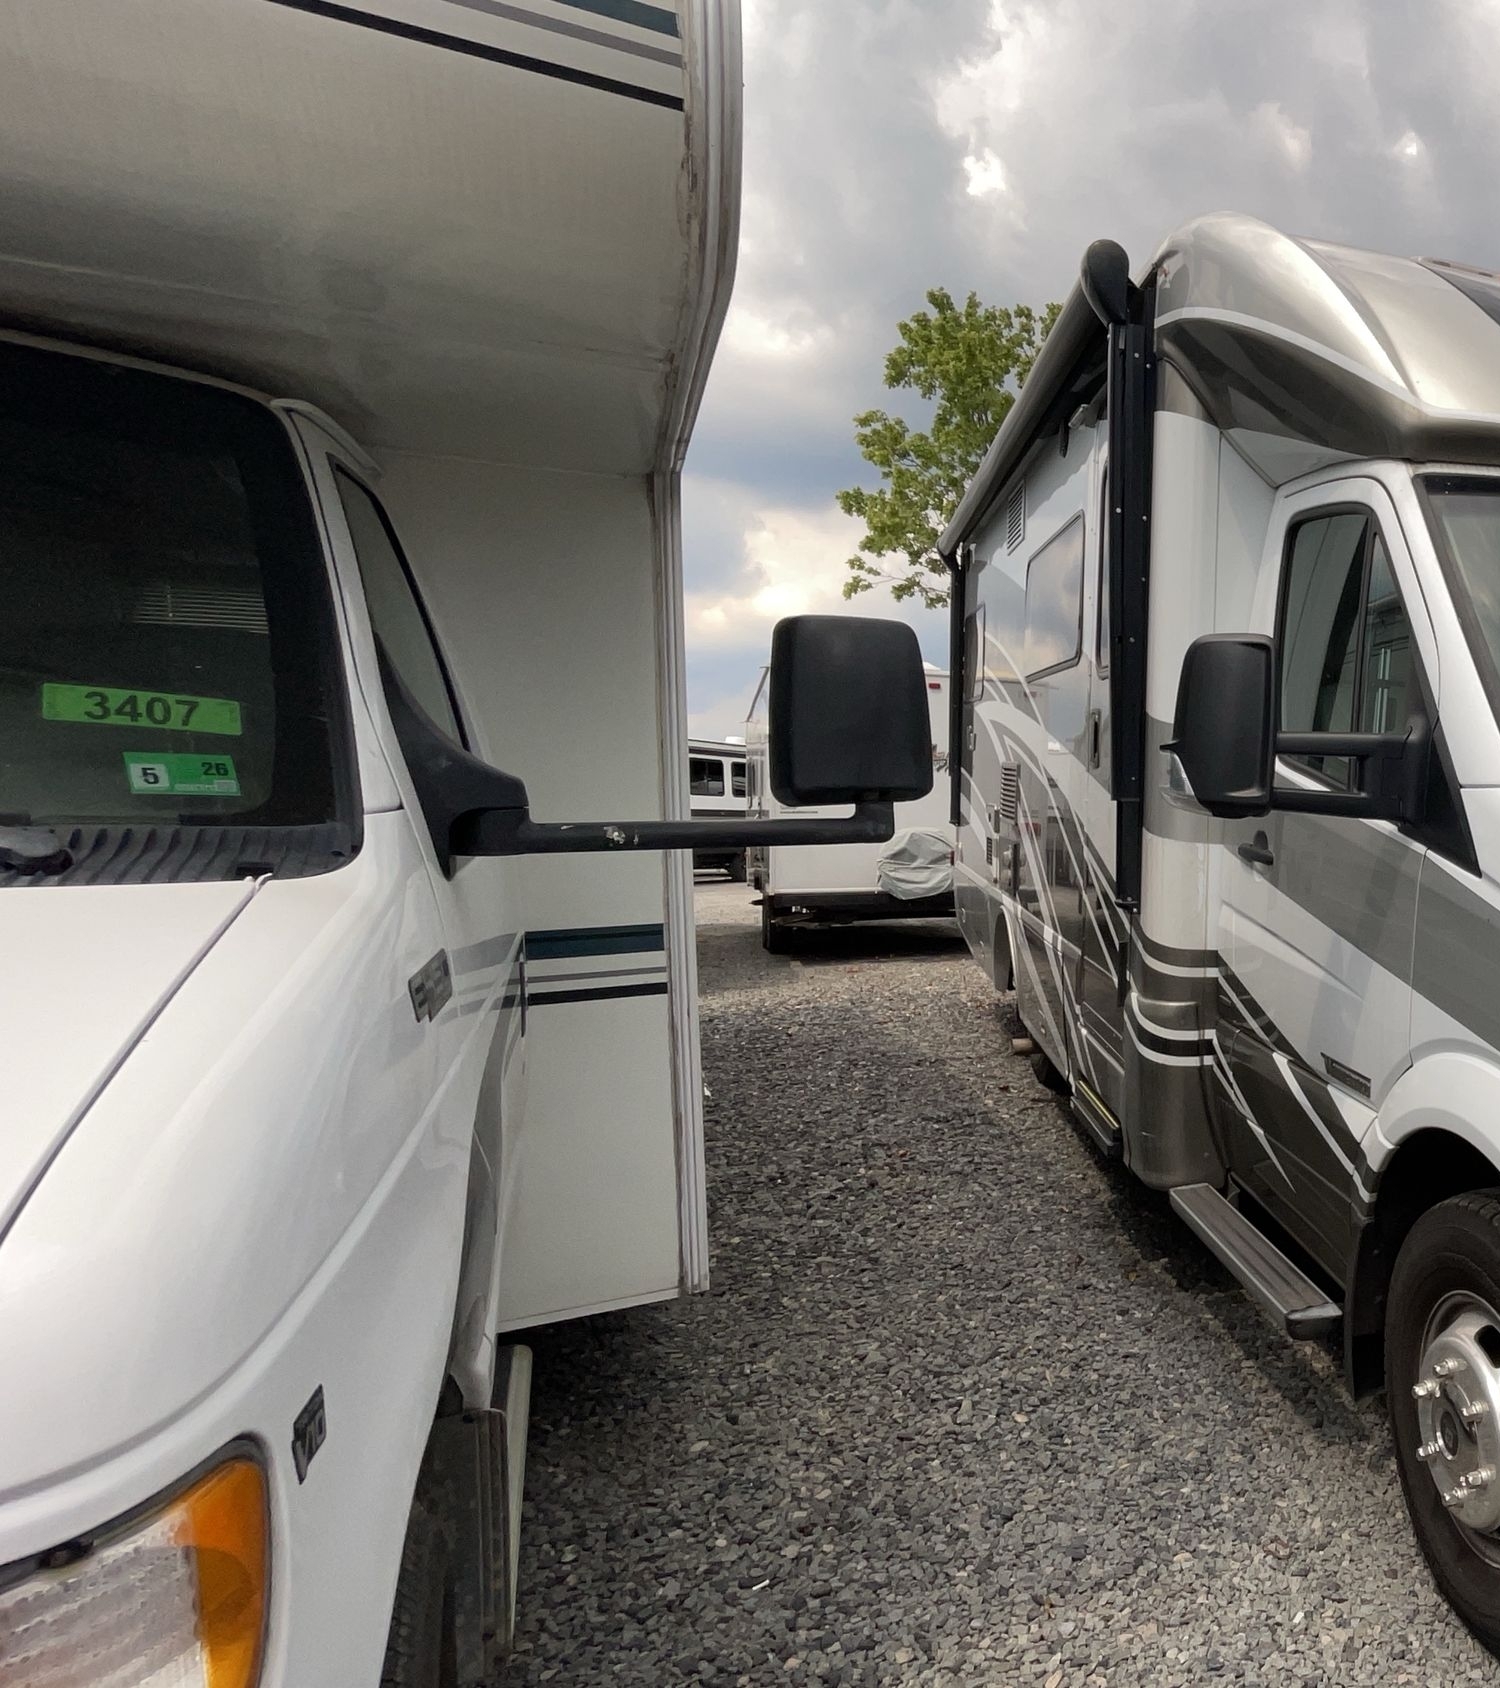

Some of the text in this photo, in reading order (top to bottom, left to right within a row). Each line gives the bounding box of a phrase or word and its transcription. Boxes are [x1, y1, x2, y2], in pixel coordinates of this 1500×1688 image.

[83, 691, 200, 728] 3407
[140, 761, 229, 785] 5 26
